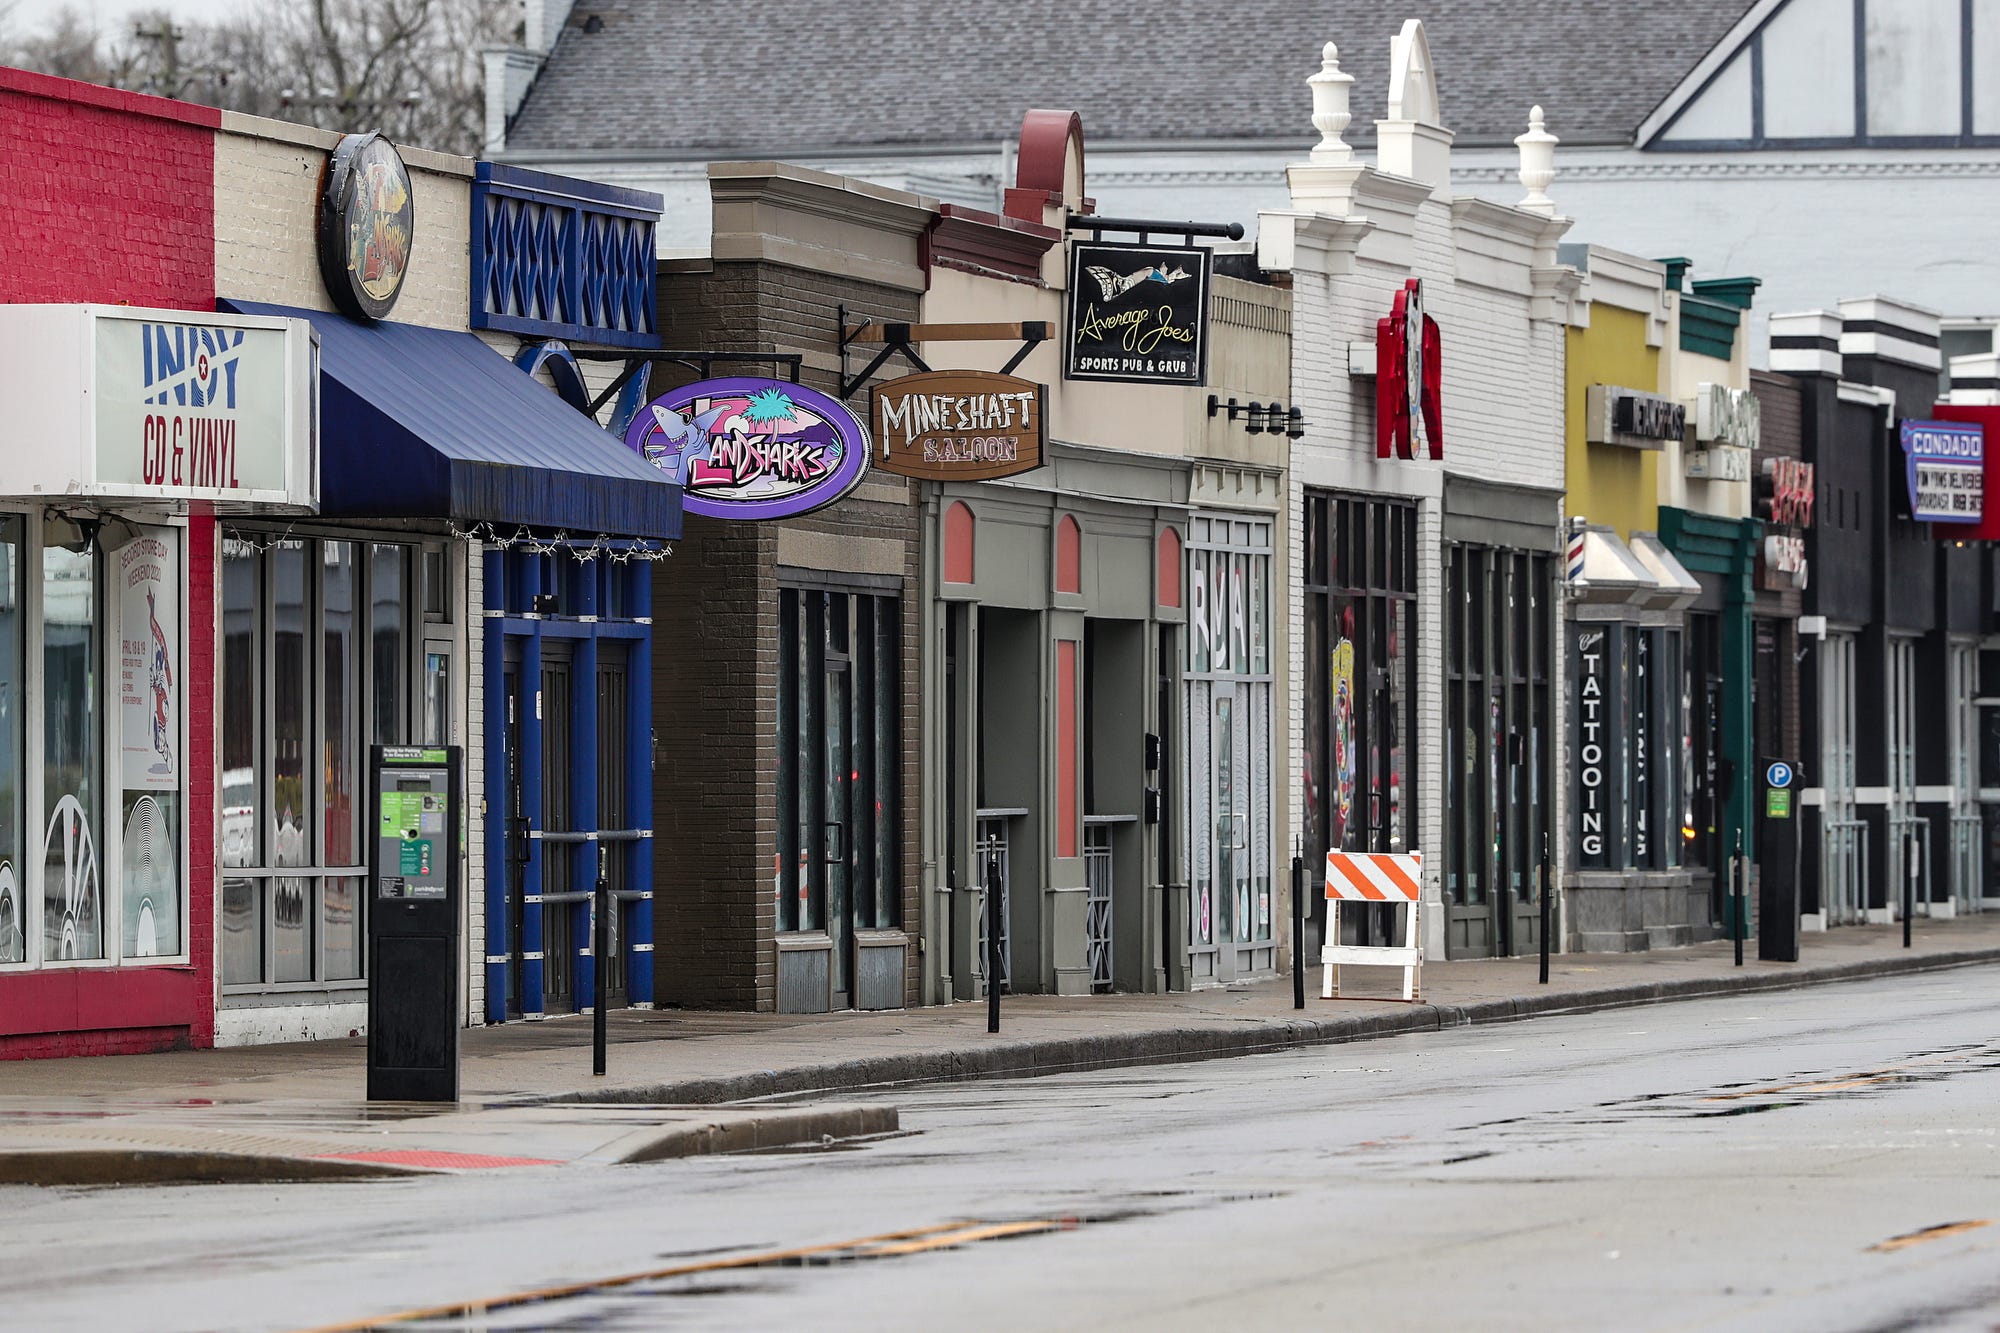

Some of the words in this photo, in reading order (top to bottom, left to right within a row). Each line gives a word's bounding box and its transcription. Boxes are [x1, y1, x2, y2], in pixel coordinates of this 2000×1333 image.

[1078, 303, 1149, 352] Average
[143, 324, 244, 409] INDY
[1080, 357, 1119, 371] SPORTS
[1122, 358, 1142, 371] PUB
[1147, 359, 1154, 372] &
[1158, 360, 1186, 373] GRUB
[880, 391, 1034, 462] MINESHAFT
[143, 414, 166, 485] CD
[172, 416, 183, 485] &
[189, 418, 239, 488] VINYL
[924, 437, 1017, 462] SALOON
[1913, 432, 1981, 457] CONDADO
[141, 539, 157, 556] STORE
[128, 564, 150, 588] WEEKEND
[1582, 654, 1602, 856] TATTOOING
[1774, 766, 1787, 783] P
